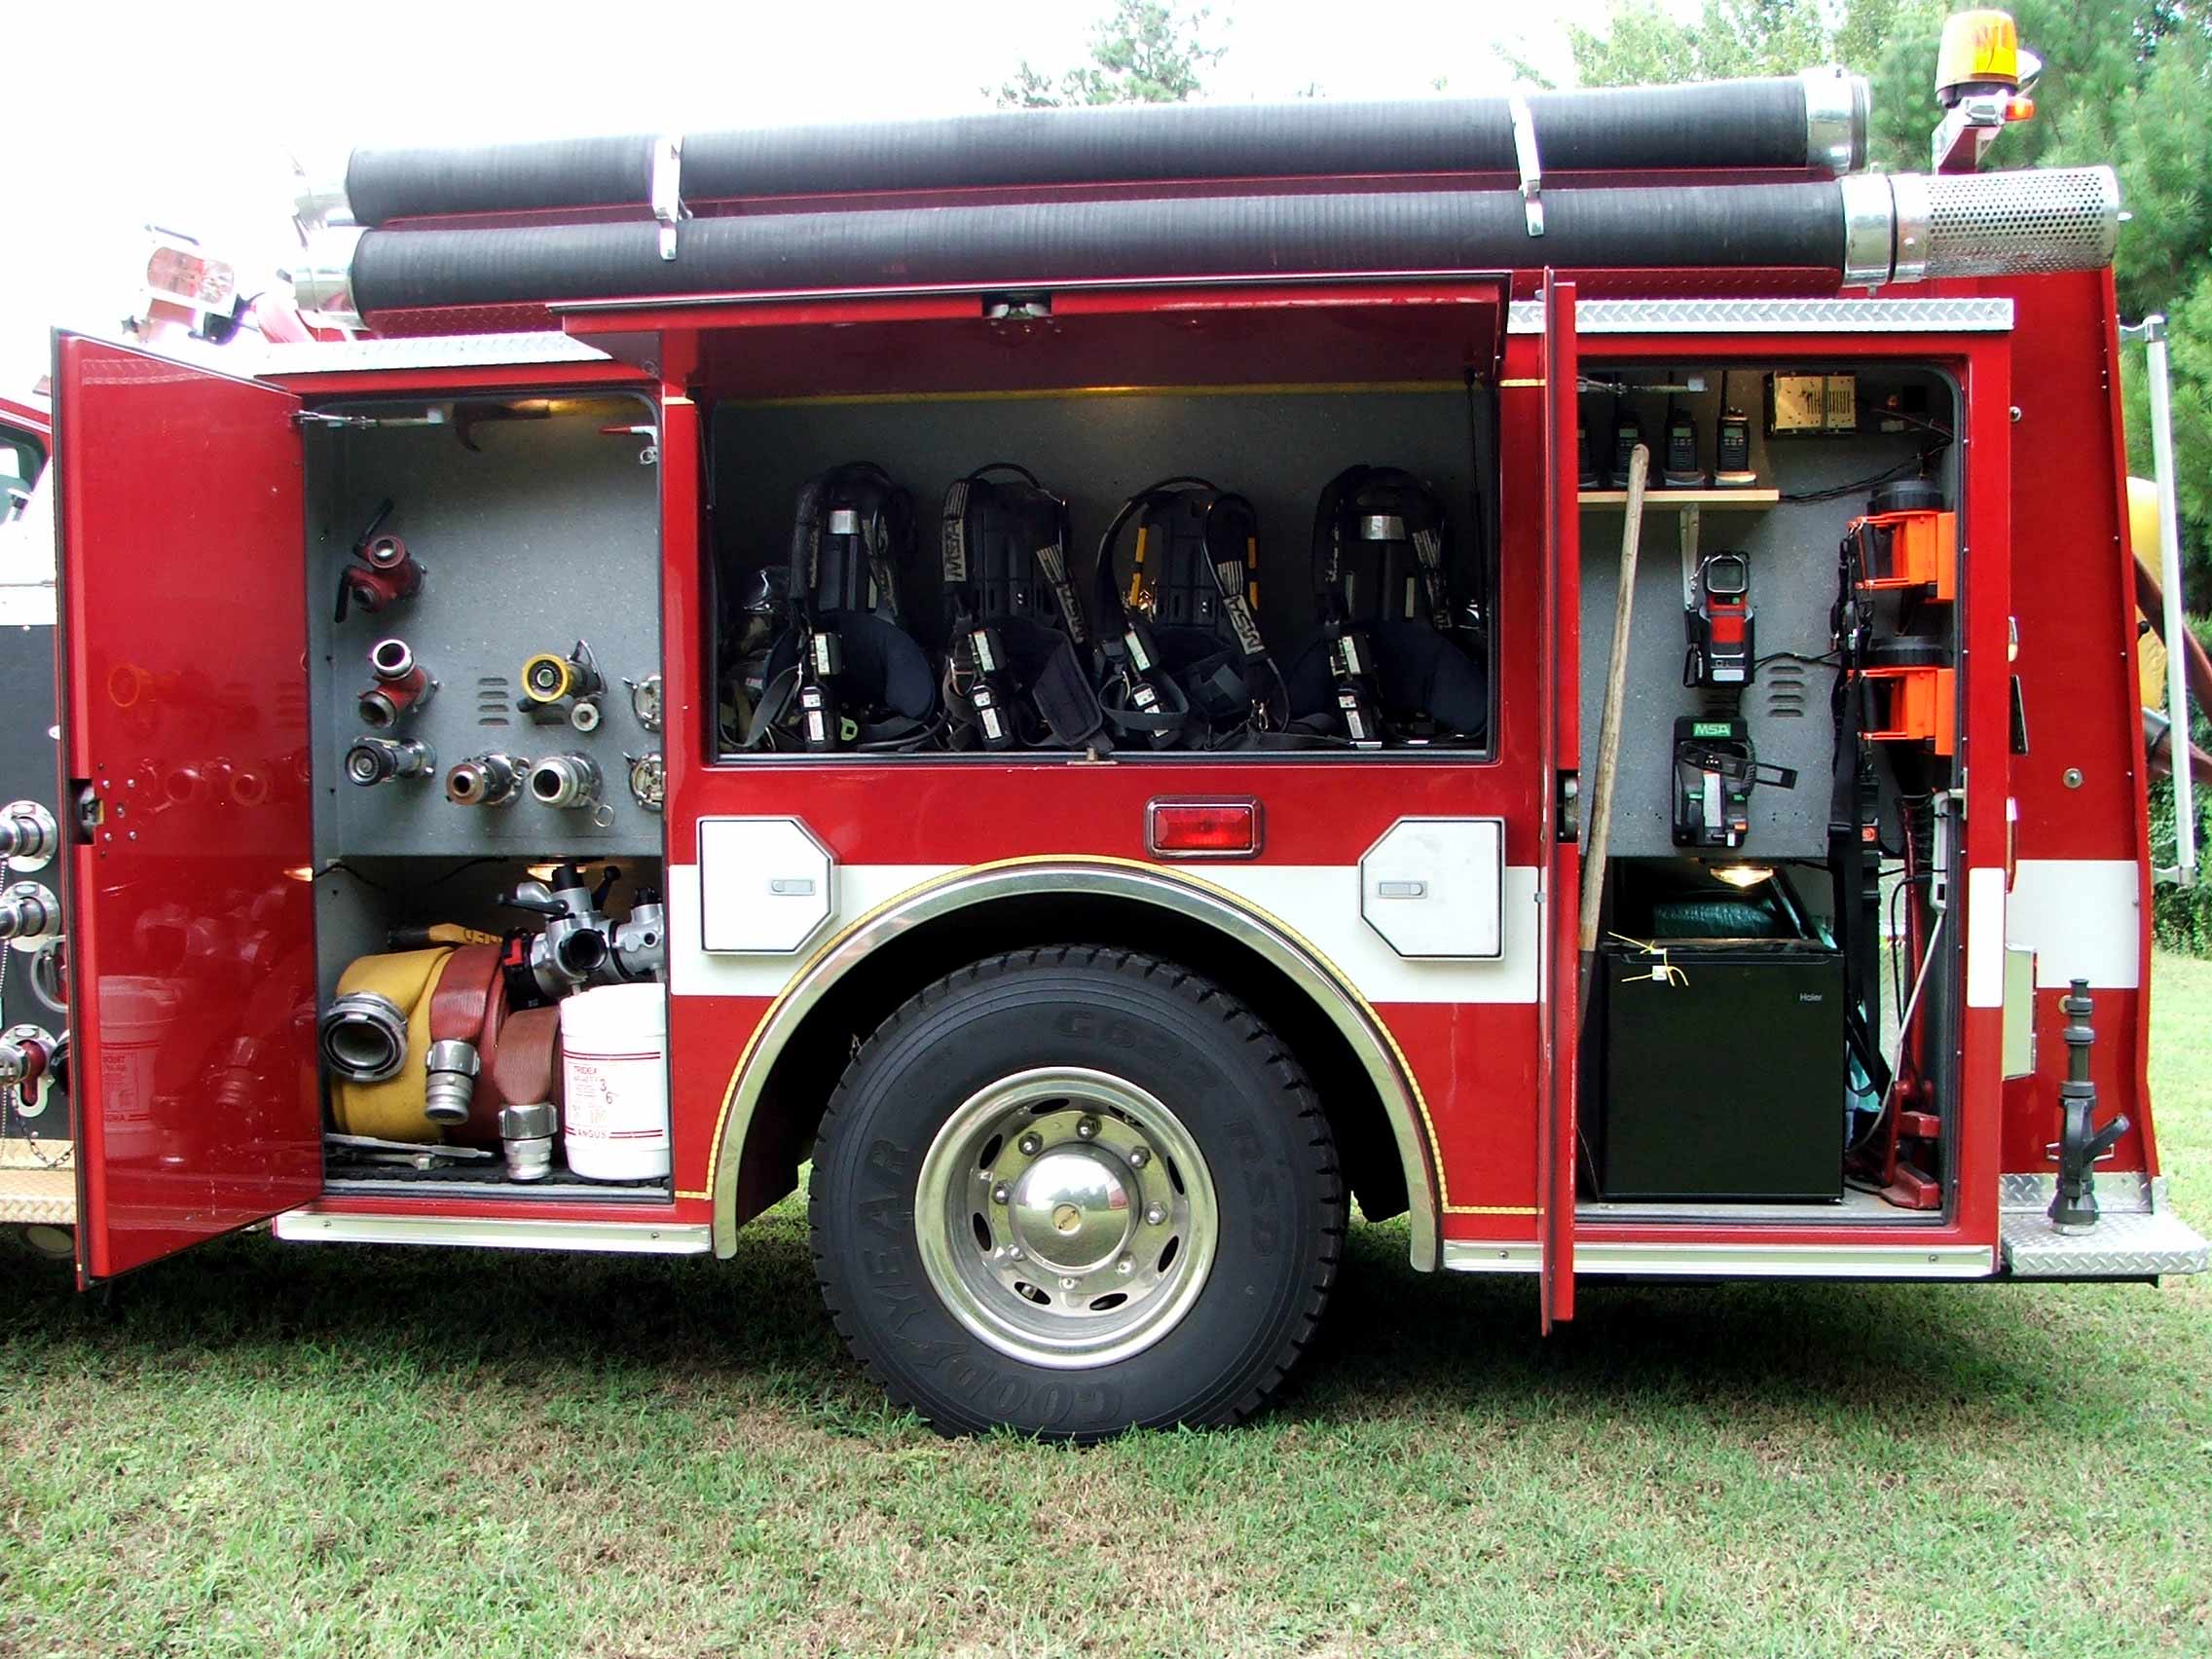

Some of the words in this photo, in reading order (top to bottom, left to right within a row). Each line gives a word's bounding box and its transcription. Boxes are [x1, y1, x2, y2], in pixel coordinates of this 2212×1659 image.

[1694, 723, 1731, 736] MSA
[1799, 992, 1823, 1002] Haier
[859, 1138, 1123, 1423] GOODYEAR
